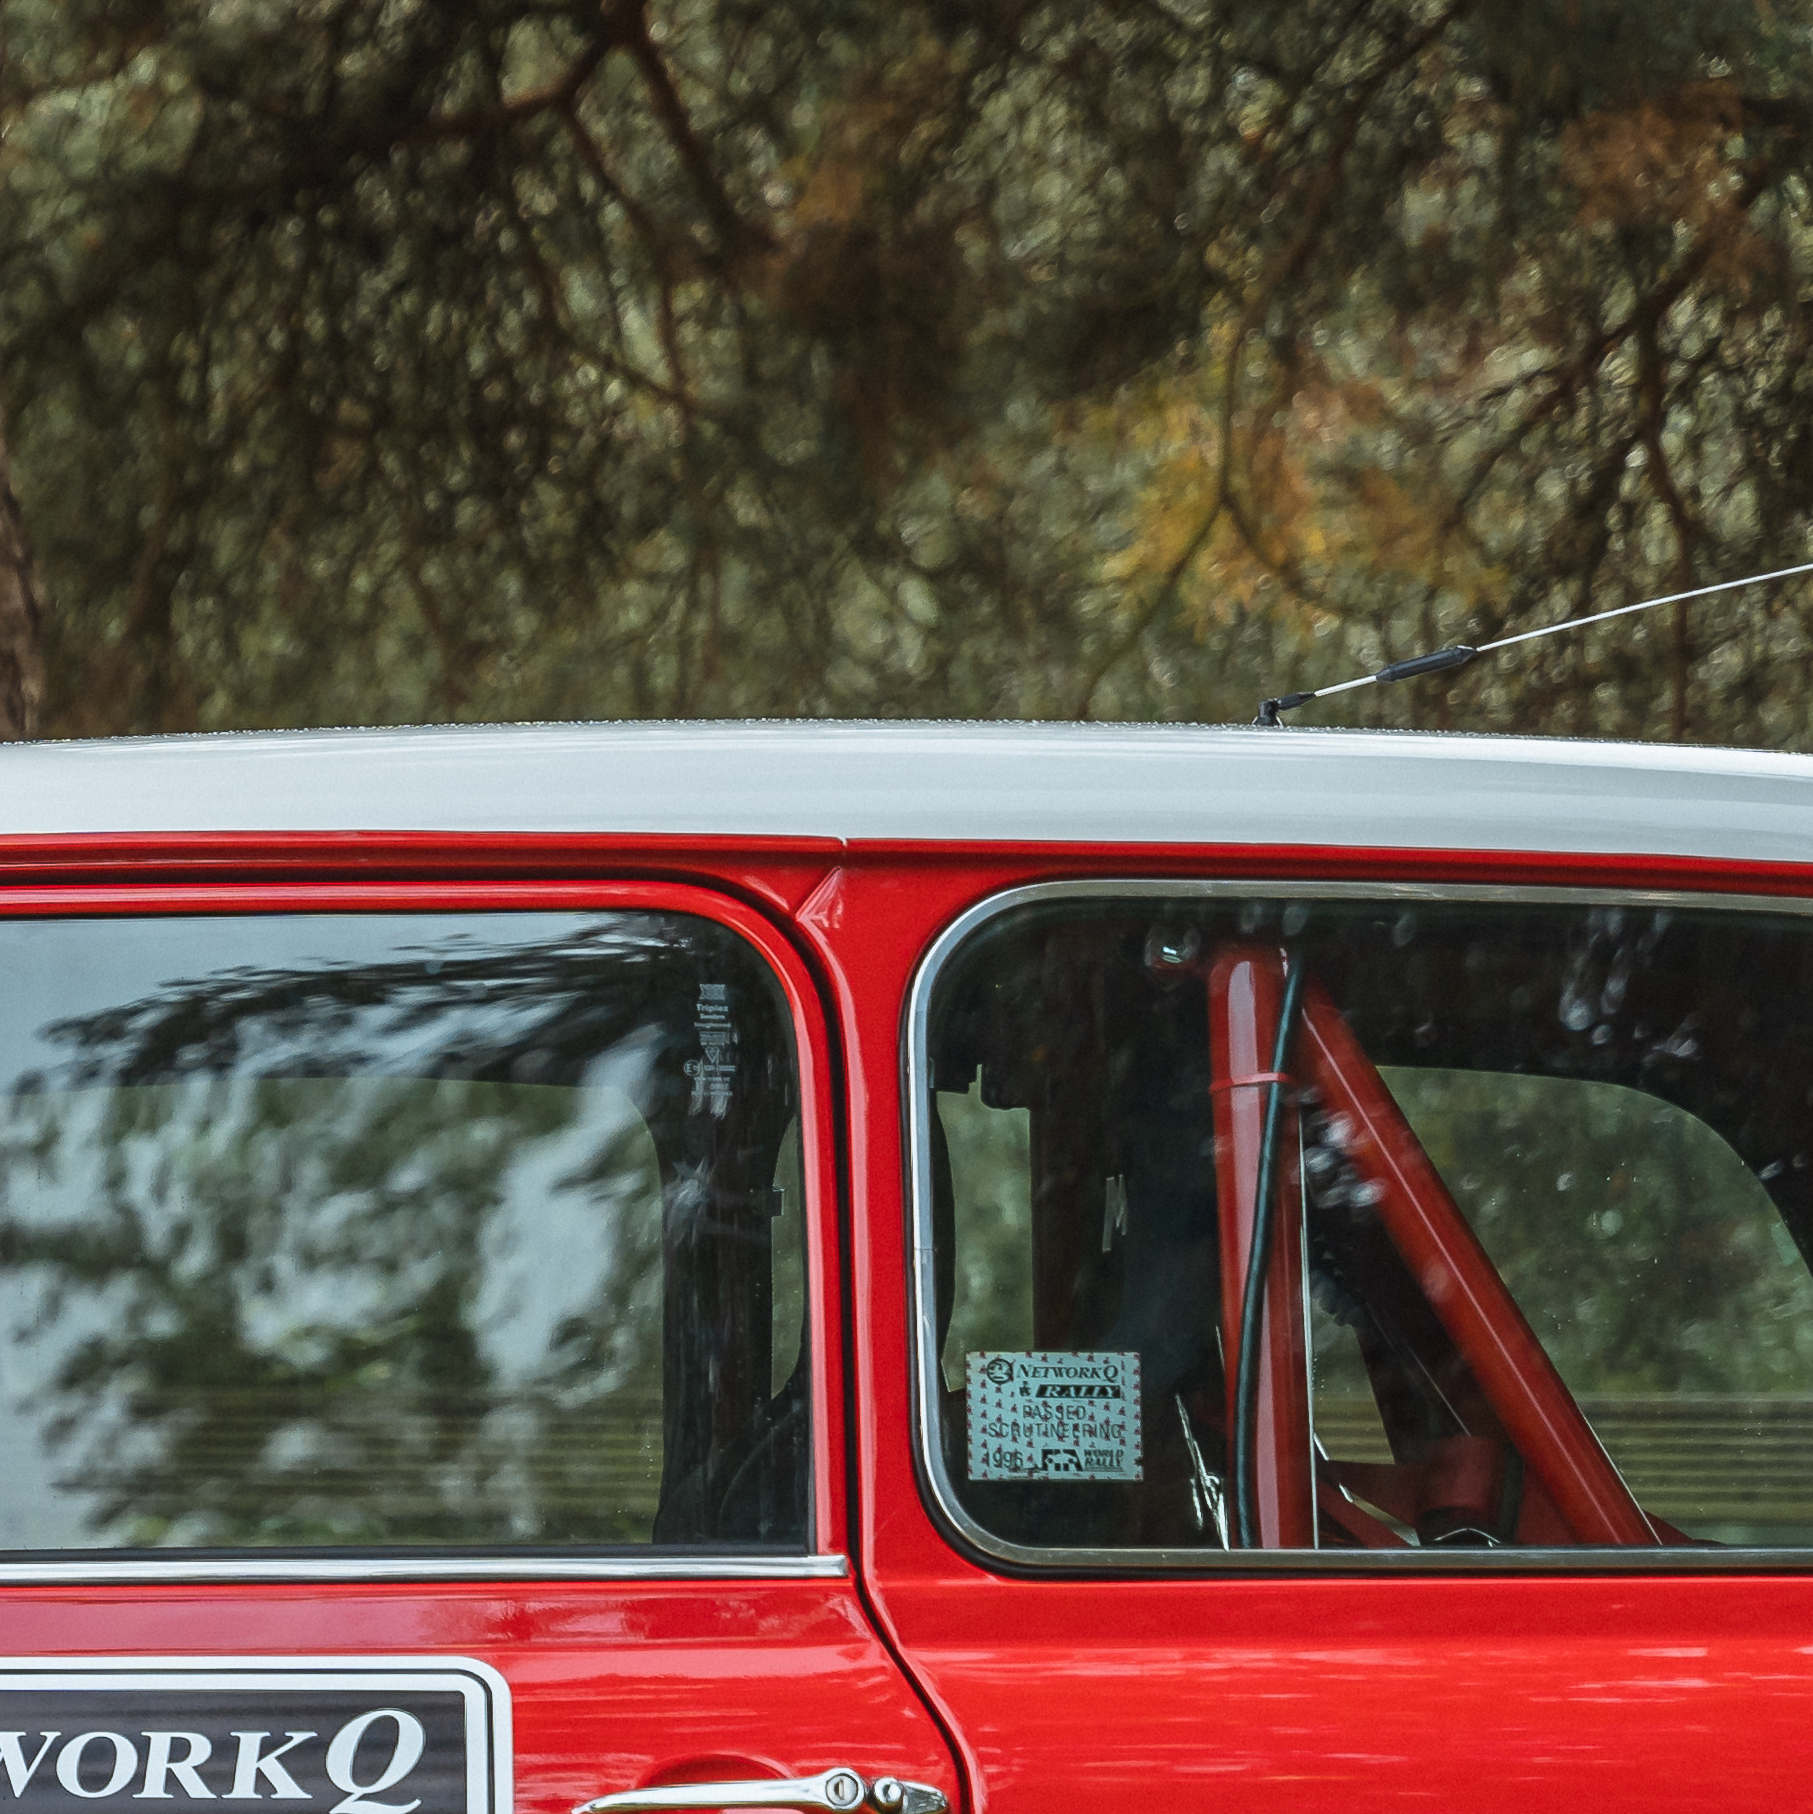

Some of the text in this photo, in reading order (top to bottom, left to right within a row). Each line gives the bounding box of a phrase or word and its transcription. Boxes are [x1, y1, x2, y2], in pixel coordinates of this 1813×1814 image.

[1046, 1386, 1119, 1398] RALLY
[1022, 1405, 1087, 1420] PASSED
[987, 1423, 1122, 1439] SCRUTINEERING
[984, 1450, 1023, 1468] 1996
[1084, 1449, 1124, 1458] WORLD
[1084, 1458, 1123, 1467] RALLY
